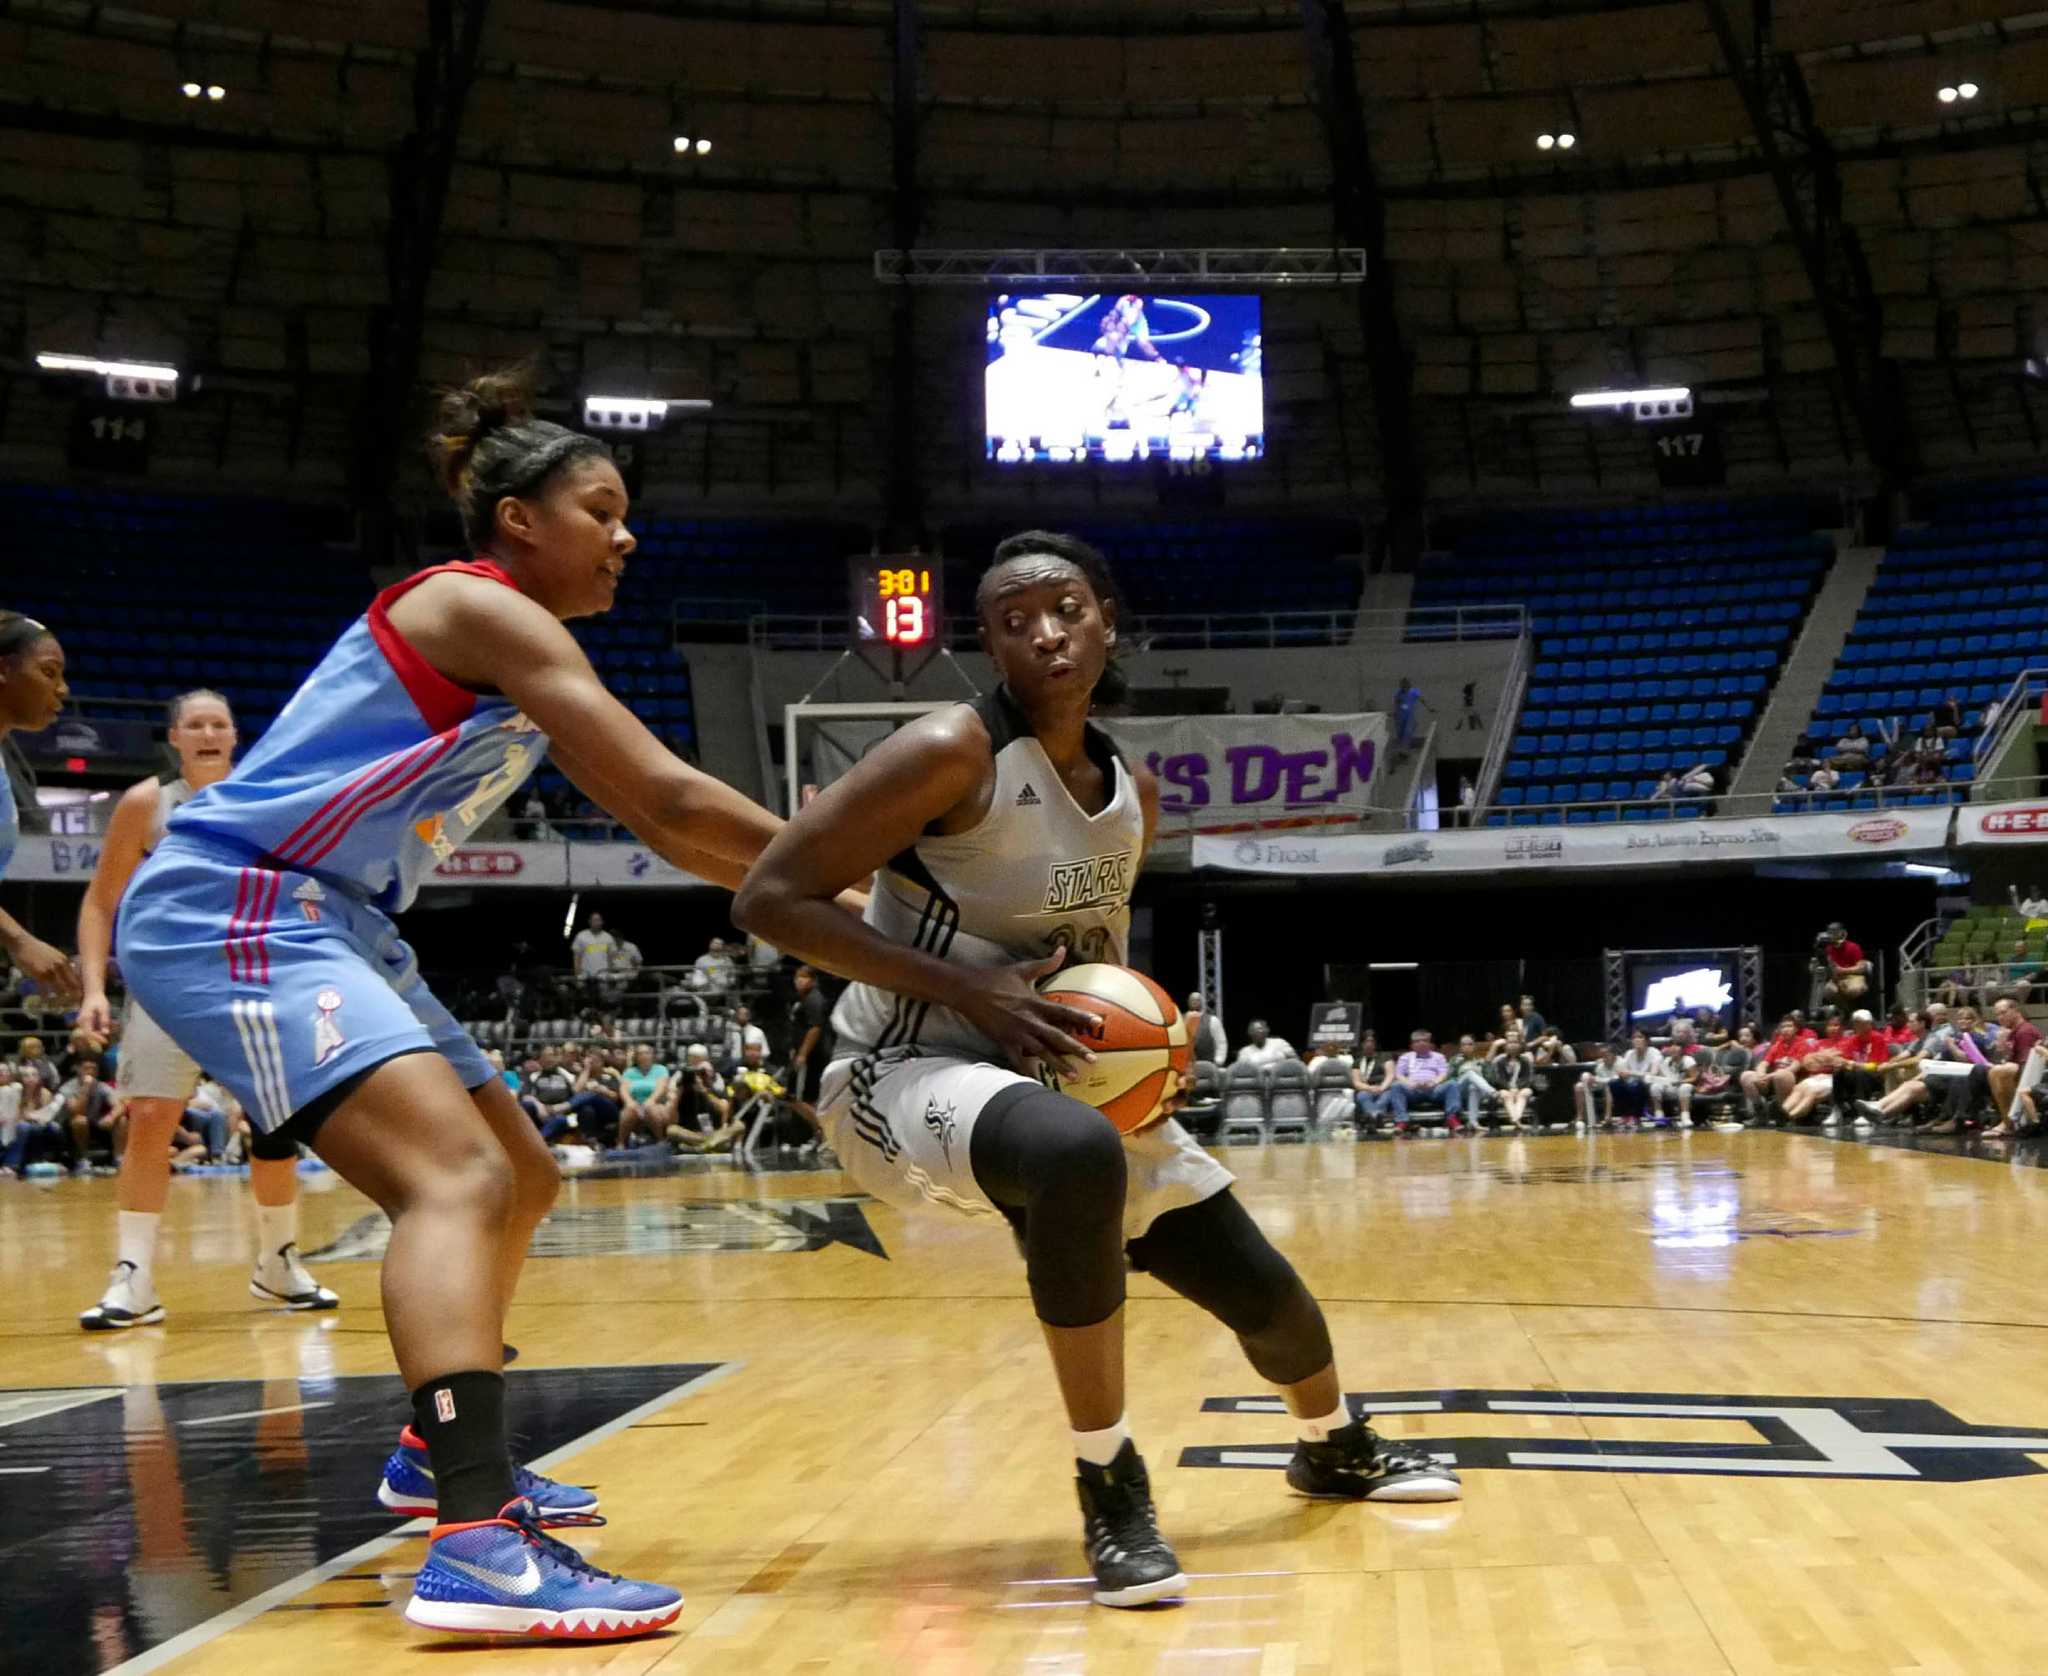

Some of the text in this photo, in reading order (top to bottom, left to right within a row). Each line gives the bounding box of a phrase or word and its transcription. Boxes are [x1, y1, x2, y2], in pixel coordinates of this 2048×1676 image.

[1657, 433, 1703, 456] 117
[879, 569, 929, 596] 3:01
[886, 596, 923, 642] 13
[1225, 732, 1376, 811] DEN
[1266, 845, 1320, 865] Frost
[1041, 850, 1132, 912] STARS
